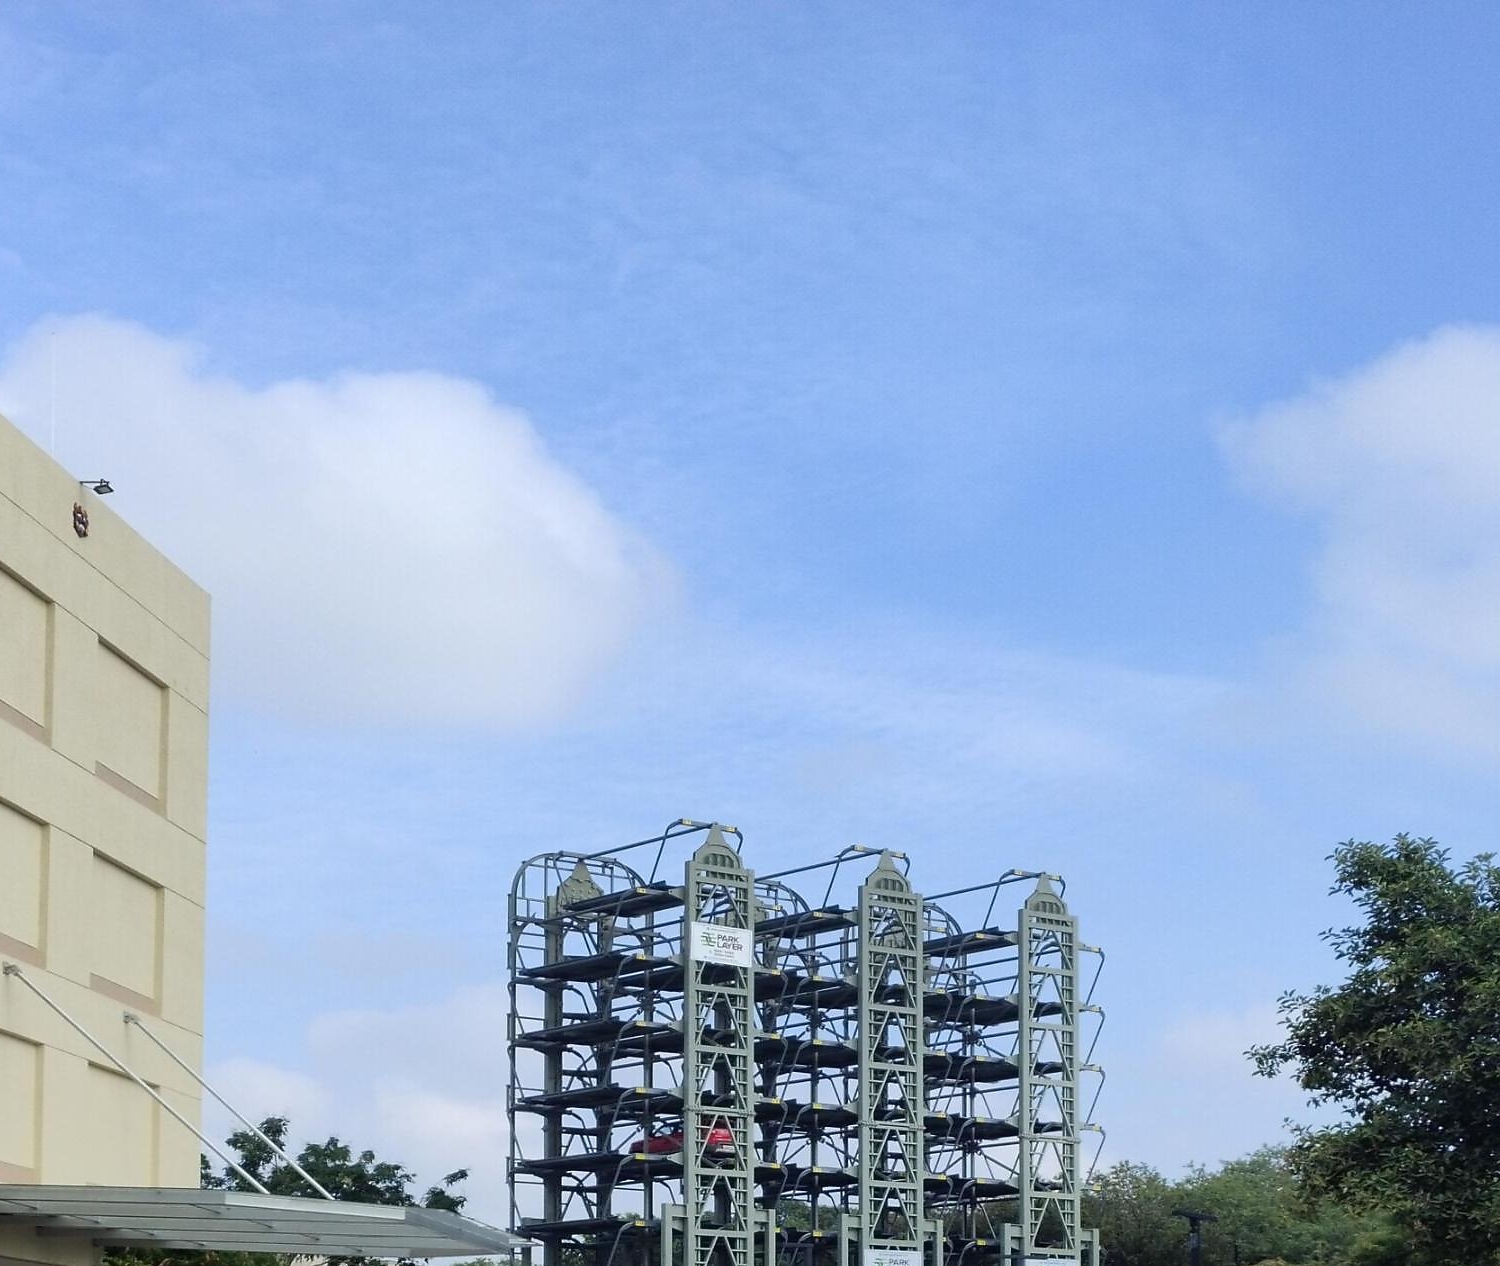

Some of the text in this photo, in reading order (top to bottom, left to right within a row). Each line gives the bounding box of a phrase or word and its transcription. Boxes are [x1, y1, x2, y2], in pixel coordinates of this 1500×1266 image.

[717, 934, 740, 943] PARK
[717, 942, 743, 951] LAYER
[888, 1258, 910, 1266] PARK
